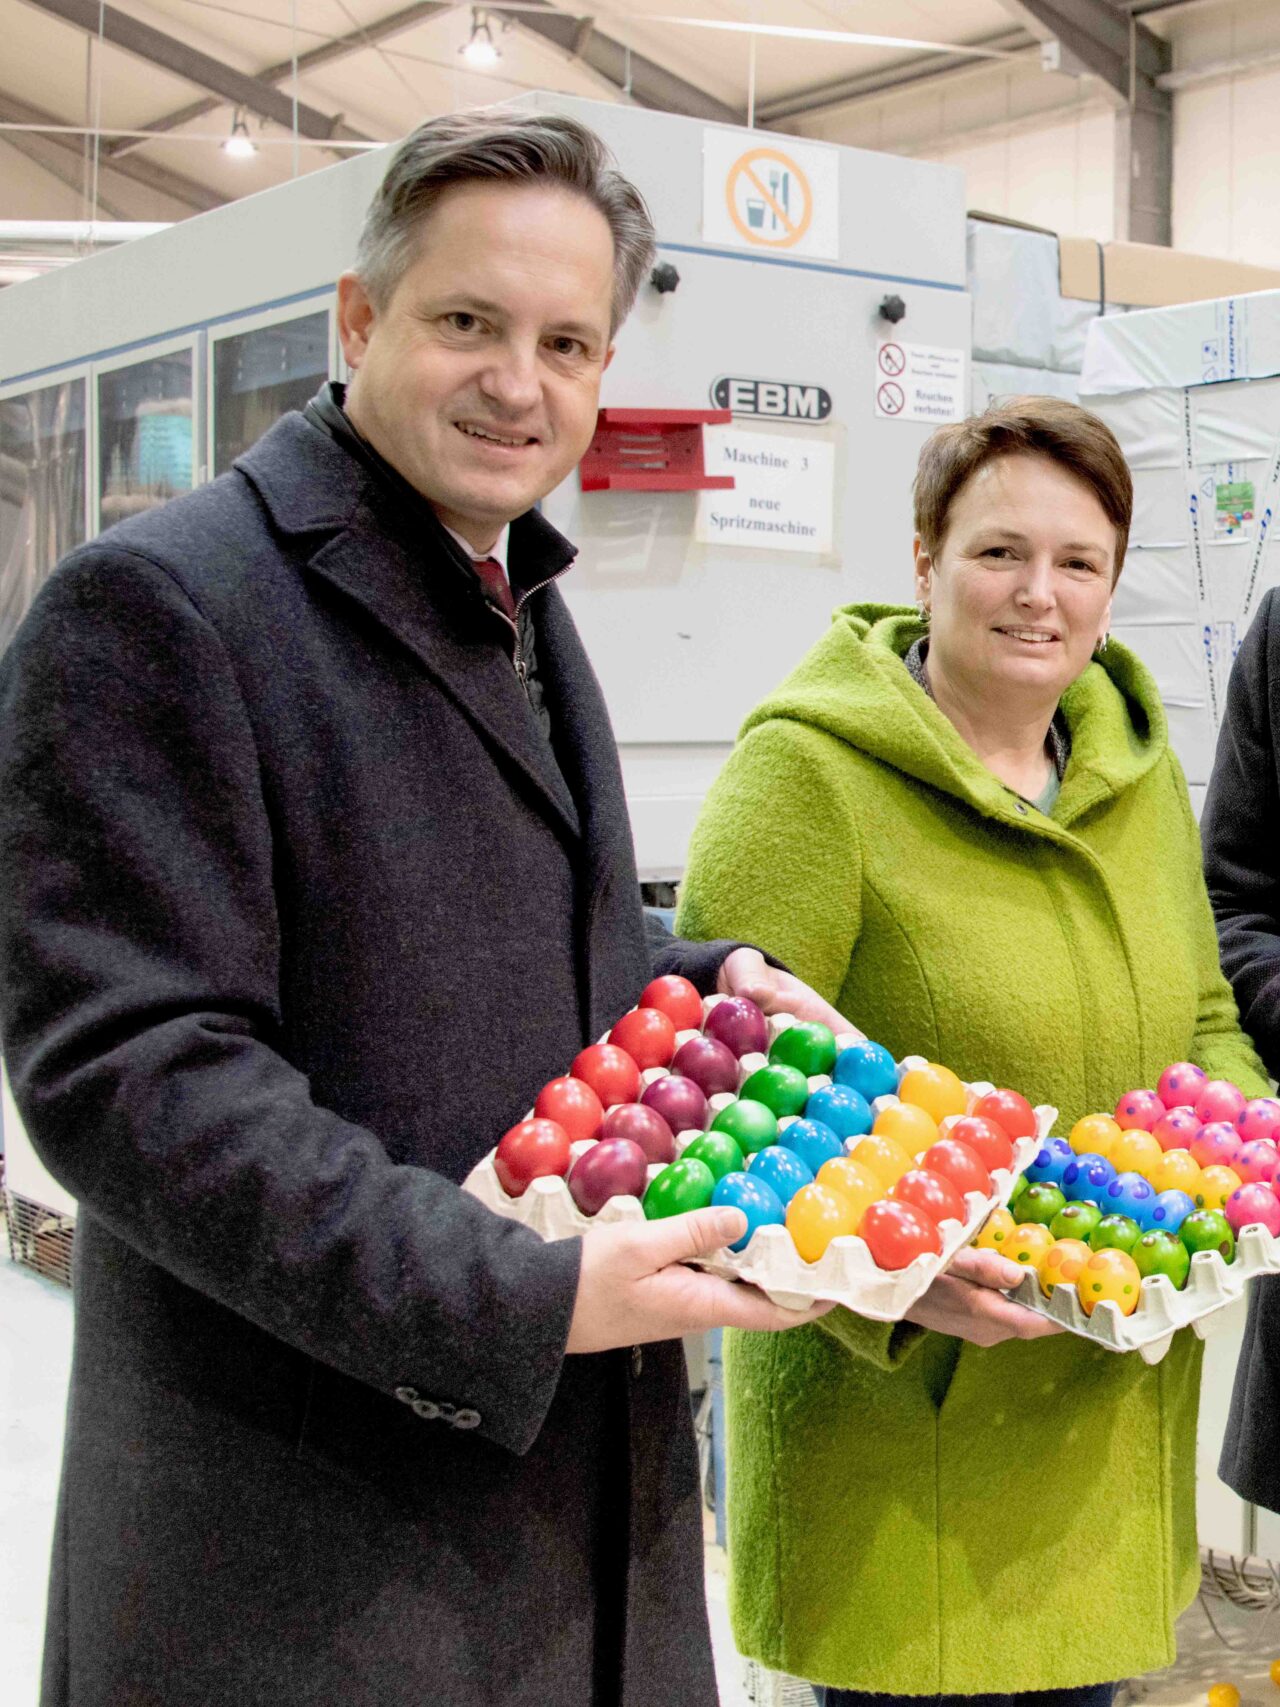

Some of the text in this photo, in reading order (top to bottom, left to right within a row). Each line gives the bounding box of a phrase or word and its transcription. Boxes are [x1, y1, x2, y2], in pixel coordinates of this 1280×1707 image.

[728, 379, 819, 419] EBM
[723, 447, 809, 471] Maschine 3
[748, 497, 781, 511] neue
[709, 512, 817, 537] Spritzmaschine
